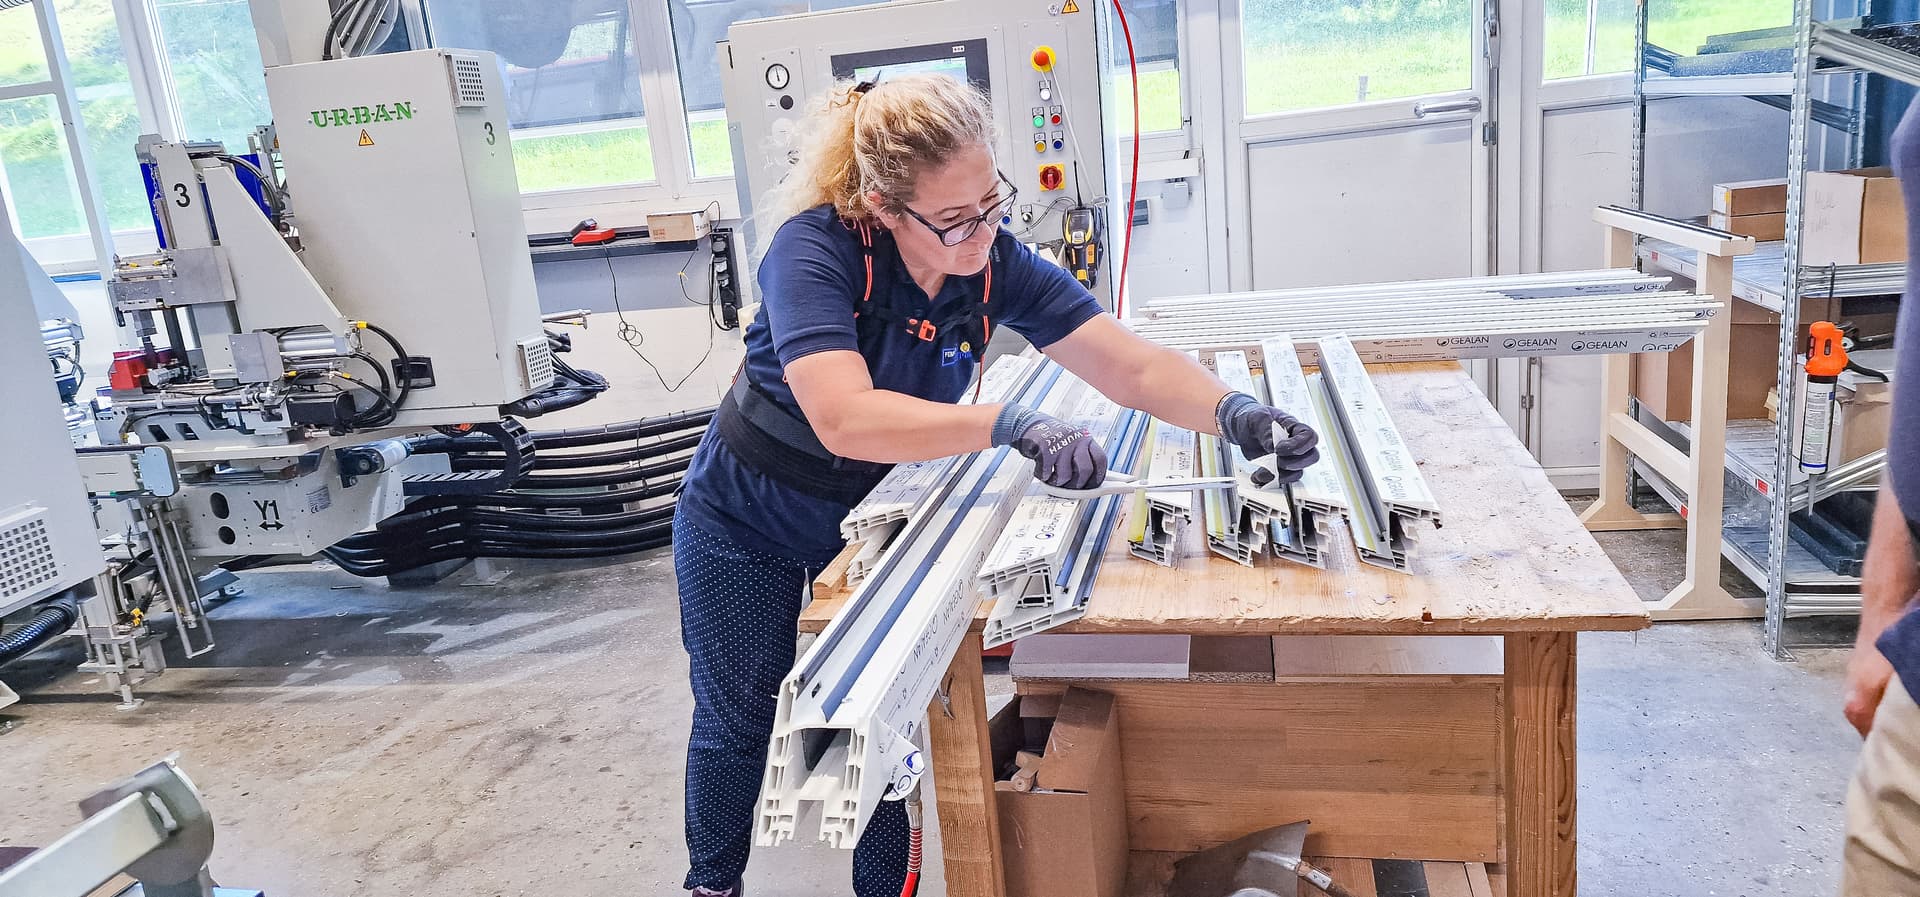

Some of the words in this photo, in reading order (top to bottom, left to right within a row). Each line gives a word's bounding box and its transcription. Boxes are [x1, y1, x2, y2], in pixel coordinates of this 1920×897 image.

[484, 121, 496, 146] 3
[173, 183, 191, 208] 3
[1450, 334, 1490, 346] GEALAN
[1517, 337, 1558, 348] GEALAN
[1591, 340, 1628, 351] GEALAN
[253, 500, 280, 520] Y1
